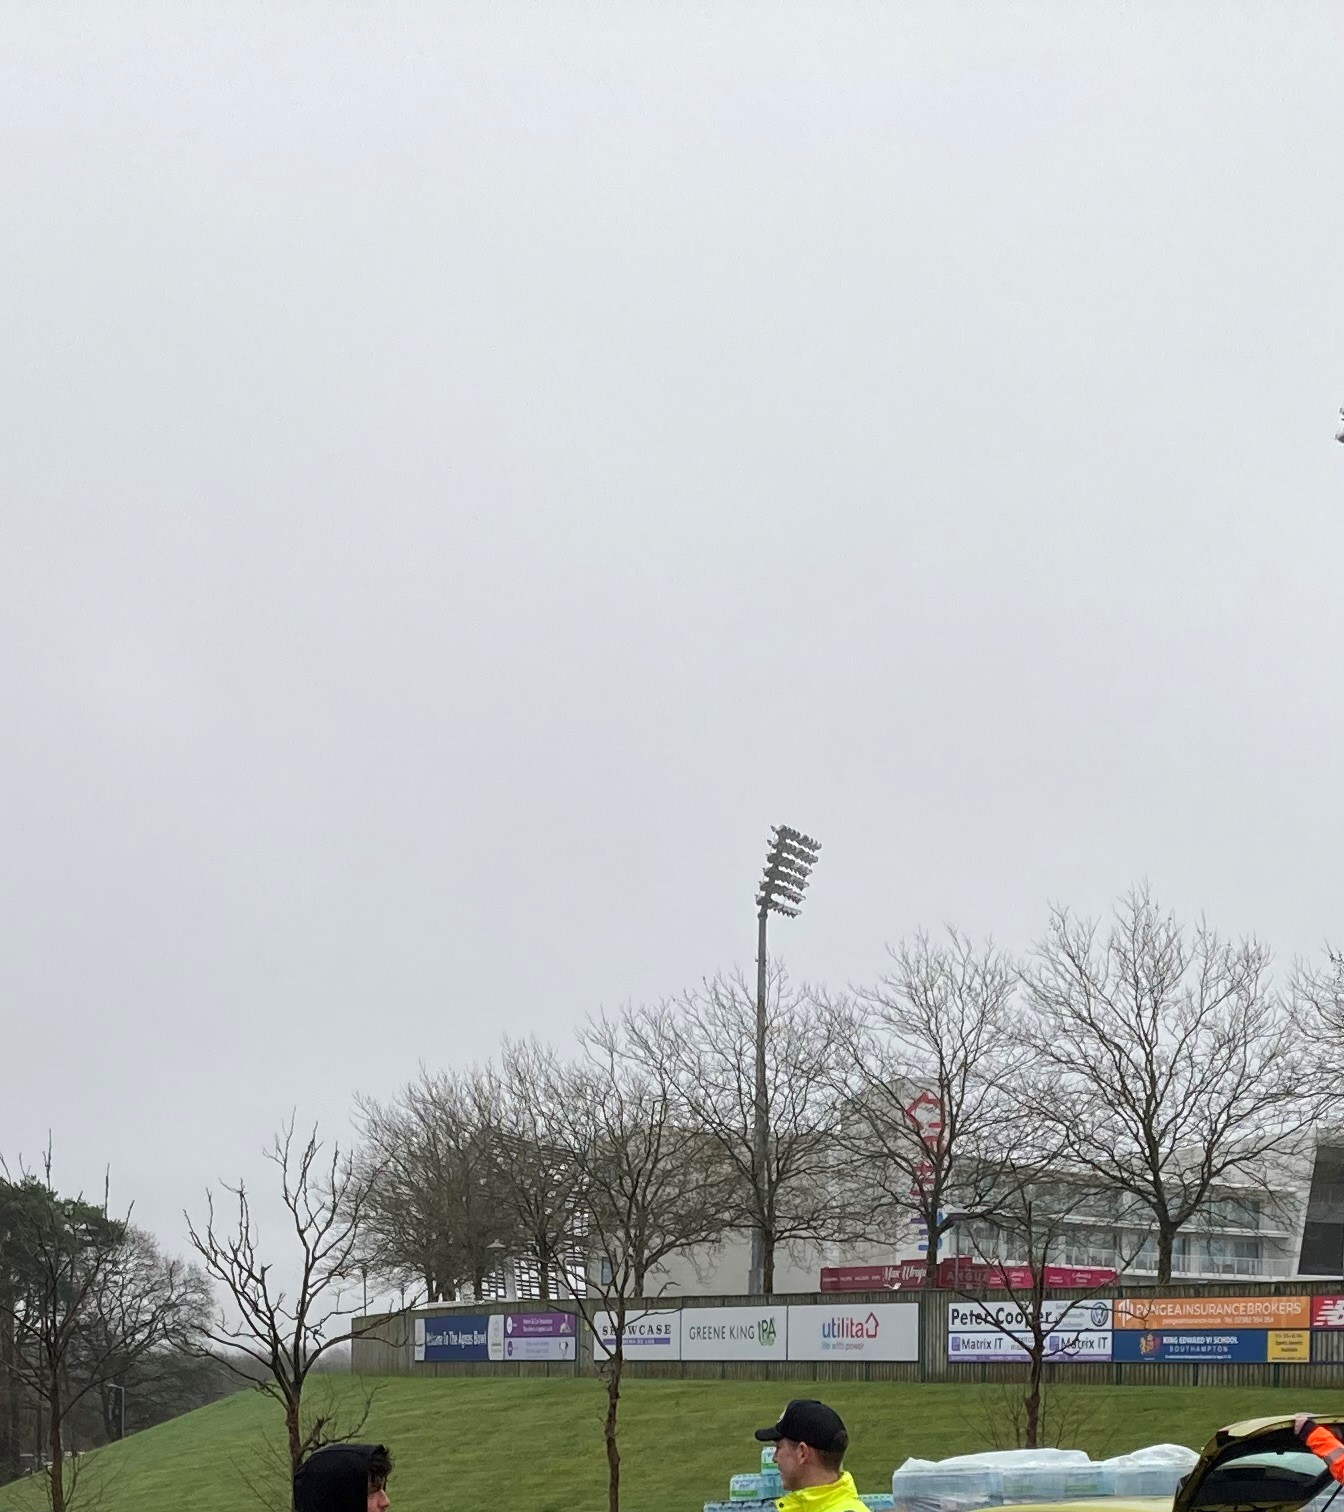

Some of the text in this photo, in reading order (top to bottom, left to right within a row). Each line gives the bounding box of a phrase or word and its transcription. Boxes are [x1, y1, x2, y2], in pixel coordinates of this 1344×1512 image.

[951, 1308, 992, 1325] Peter
[689, 1325, 726, 1340] GREENE
[729, 1325, 755, 1340] KING
[822, 1317, 864, 1338] utilita
[961, 1338, 992, 1350] Matrix
